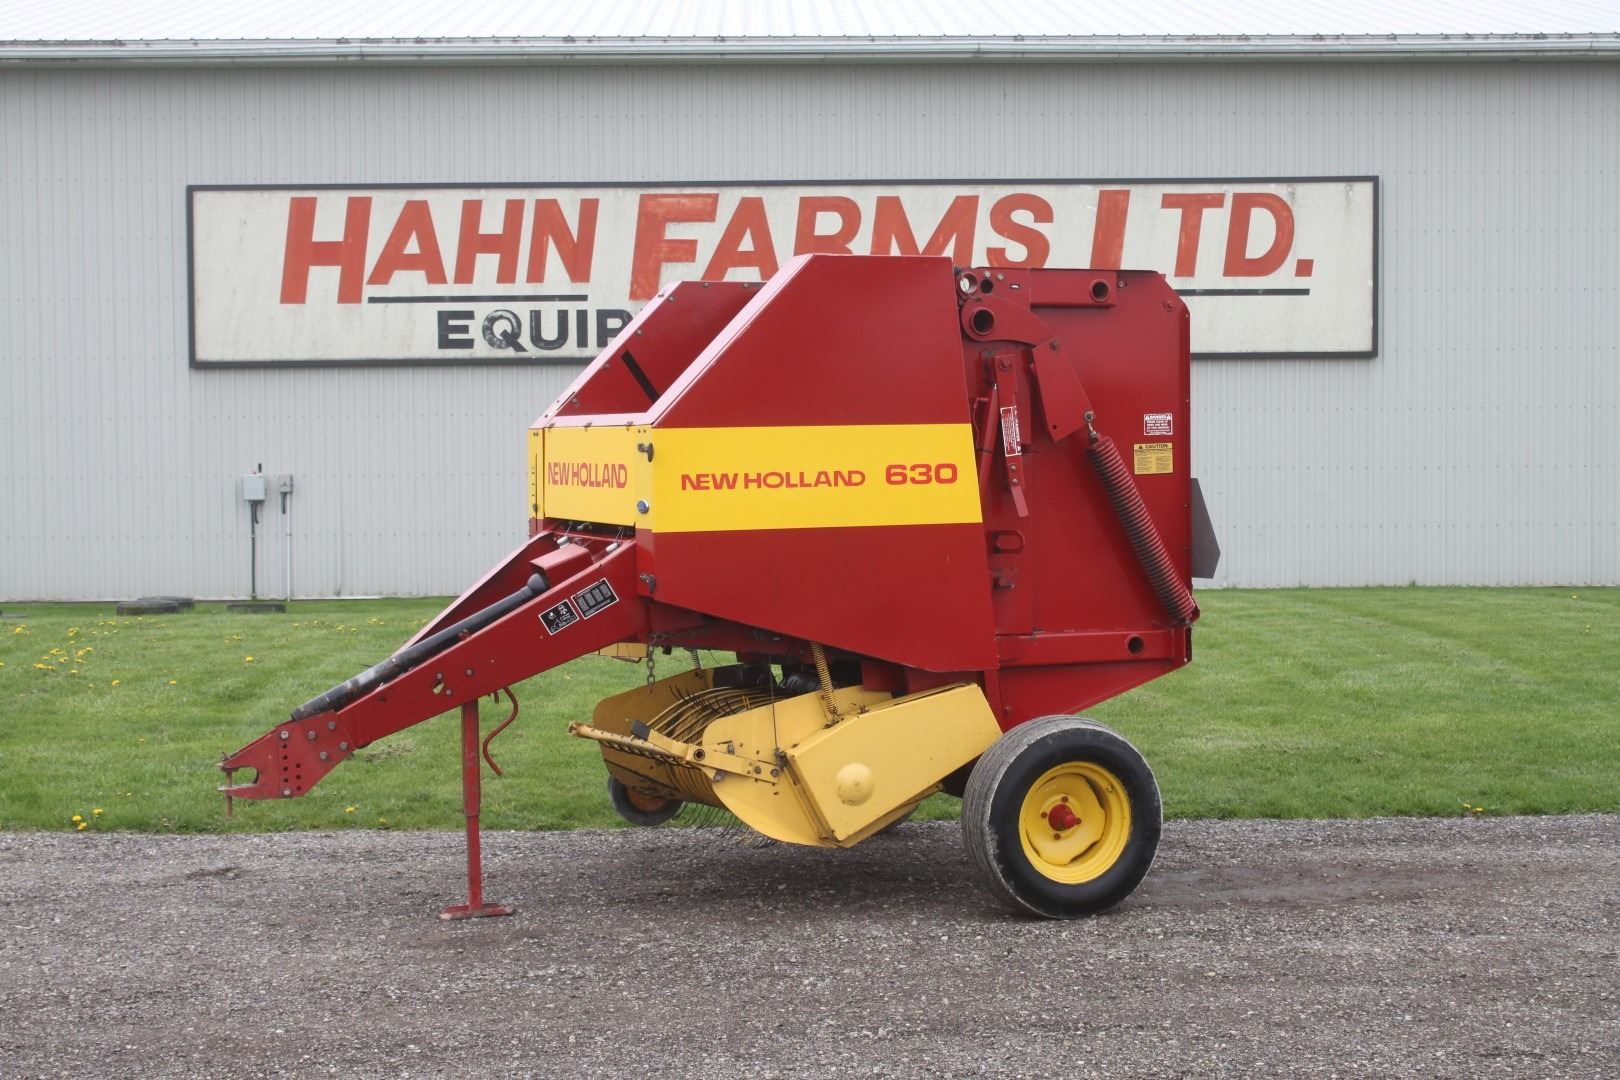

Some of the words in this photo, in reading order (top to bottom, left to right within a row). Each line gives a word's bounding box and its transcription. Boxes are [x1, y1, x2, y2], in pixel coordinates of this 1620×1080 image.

[279, 196, 599, 305] HAHN
[629, 187, 1054, 302] FARMS
[548, 463, 569, 485] NEW
[572, 463, 627, 488] HOLLAND
[682, 474, 738, 490] NEW
[744, 471, 865, 488] HOLLAND
[886, 464, 957, 485] 630
